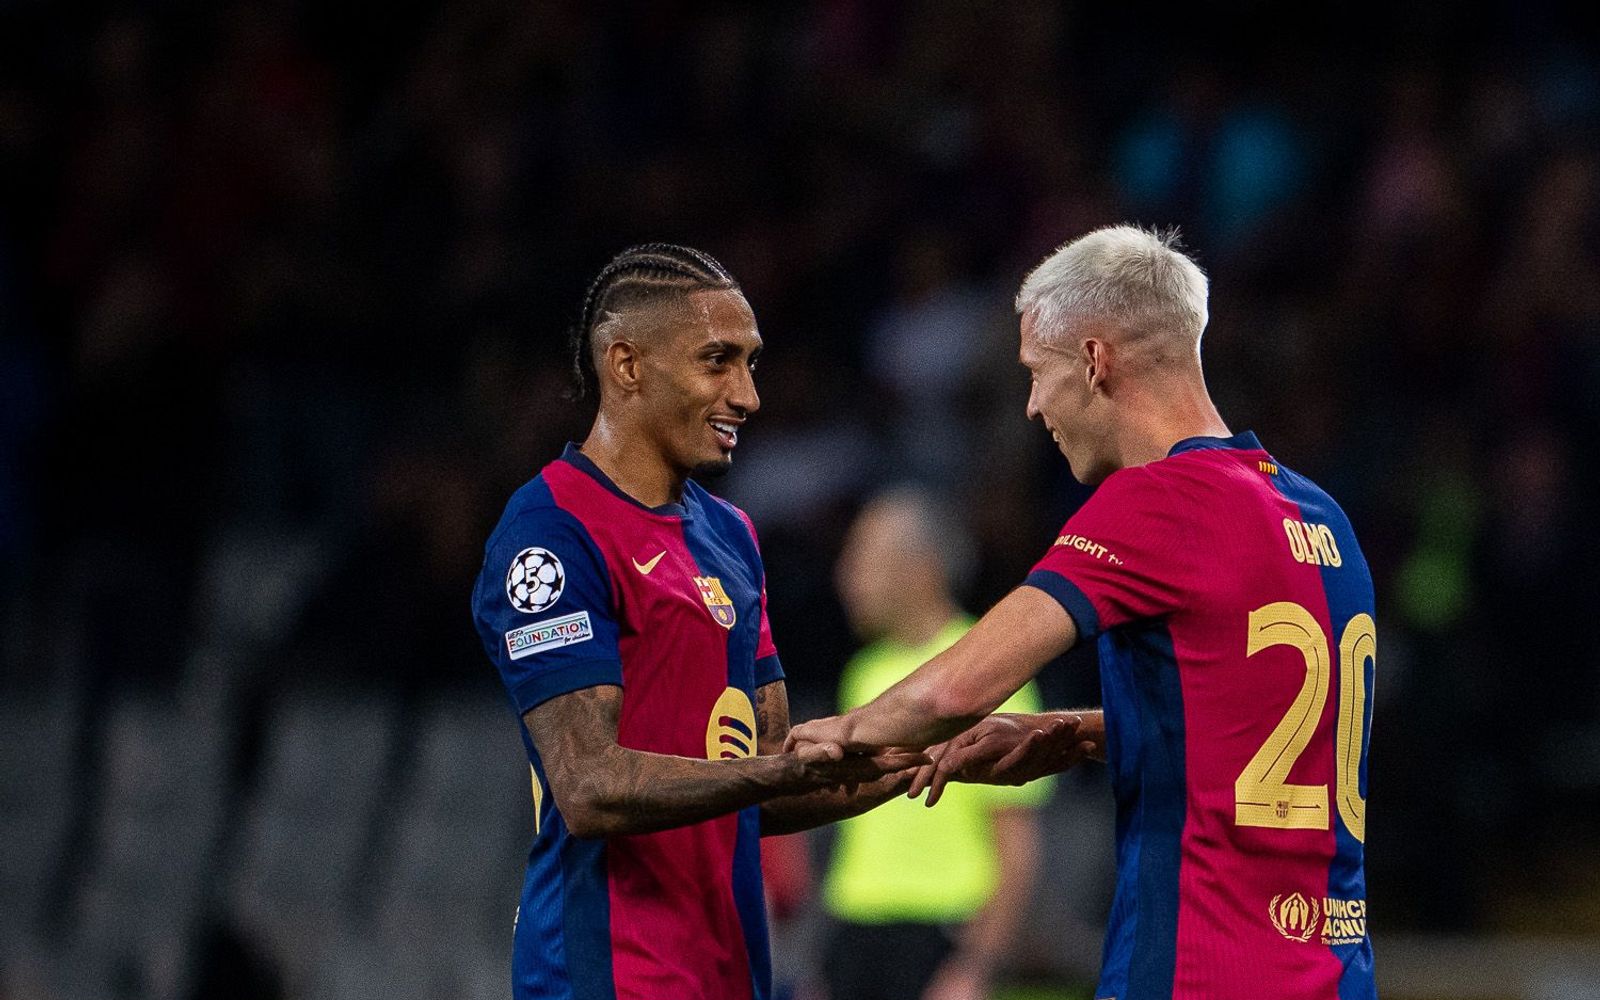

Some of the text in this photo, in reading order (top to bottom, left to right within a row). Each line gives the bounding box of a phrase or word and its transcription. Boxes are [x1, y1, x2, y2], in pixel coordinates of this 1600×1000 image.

[1283, 517, 1342, 568] OLMO
[524, 566, 540, 595] 5
[1235, 601, 1376, 844] 20
[1321, 918, 1366, 937] ACNU
